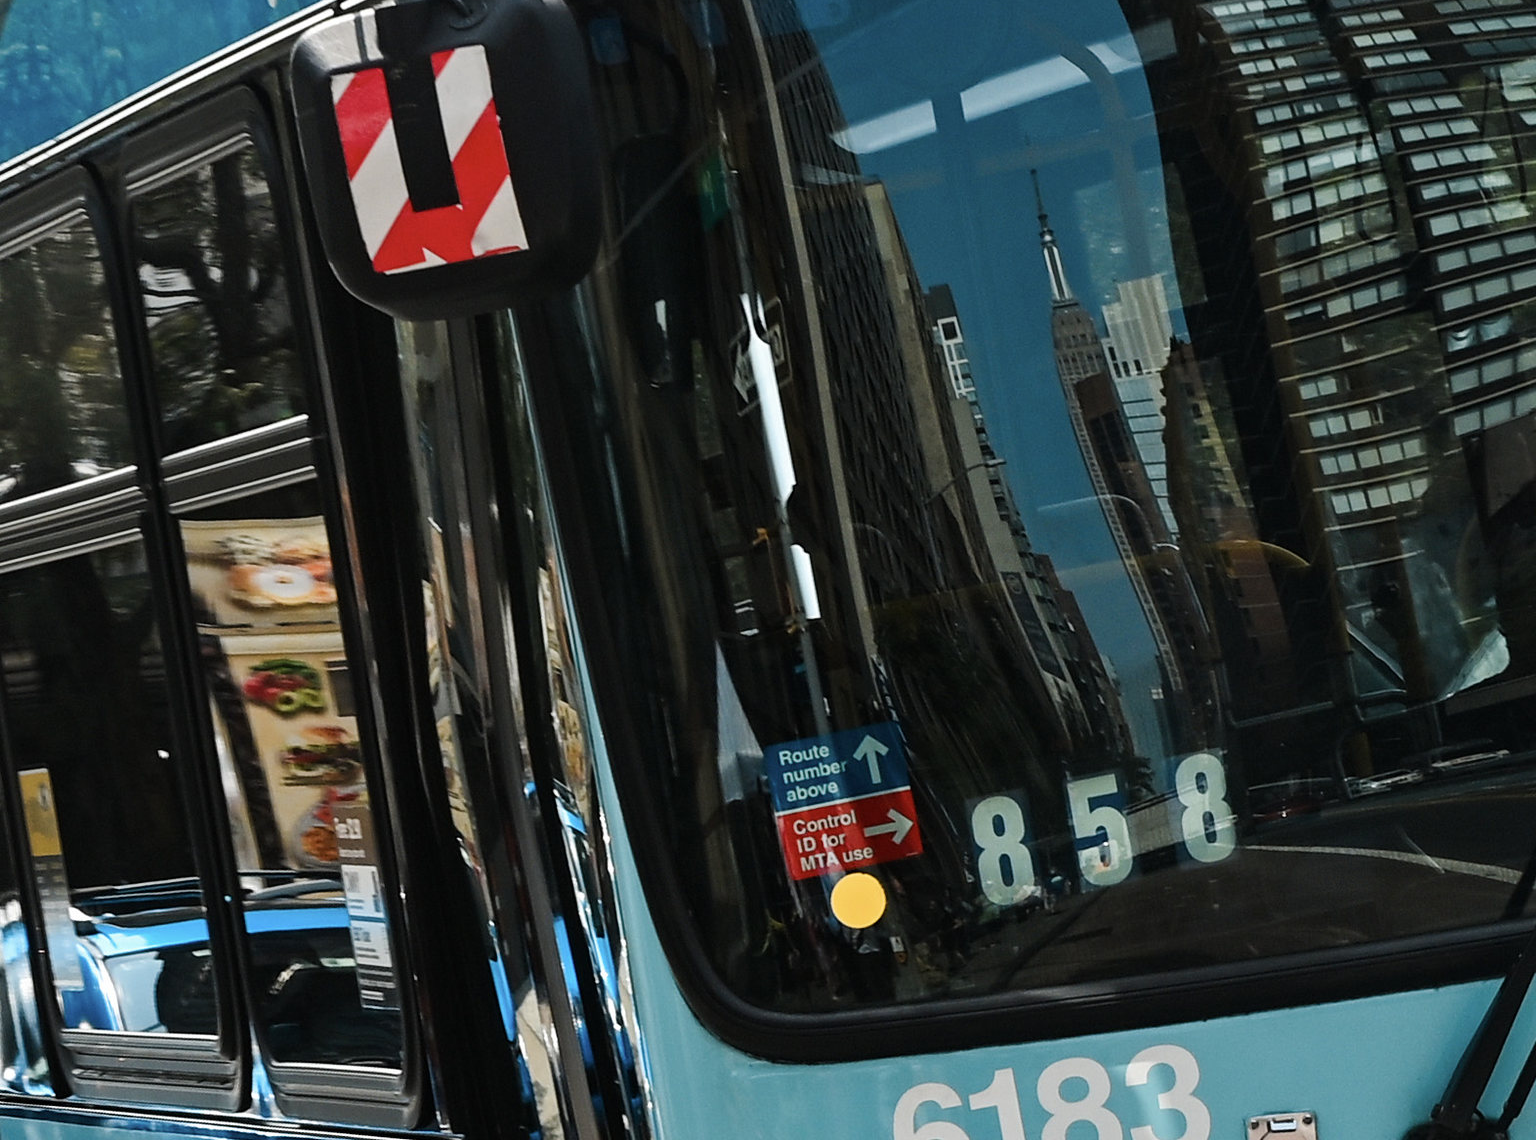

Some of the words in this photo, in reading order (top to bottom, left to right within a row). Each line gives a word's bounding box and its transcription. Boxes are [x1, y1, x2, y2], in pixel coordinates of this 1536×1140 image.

[779, 745, 830, 766] Route
[783, 761, 847, 784] number
[786, 781, 839, 802] above
[793, 810, 857, 835] Control
[797, 837, 816, 853] ID
[821, 833, 846, 849] for
[800, 852, 840, 872] MTA
[843, 847, 874, 863] use
